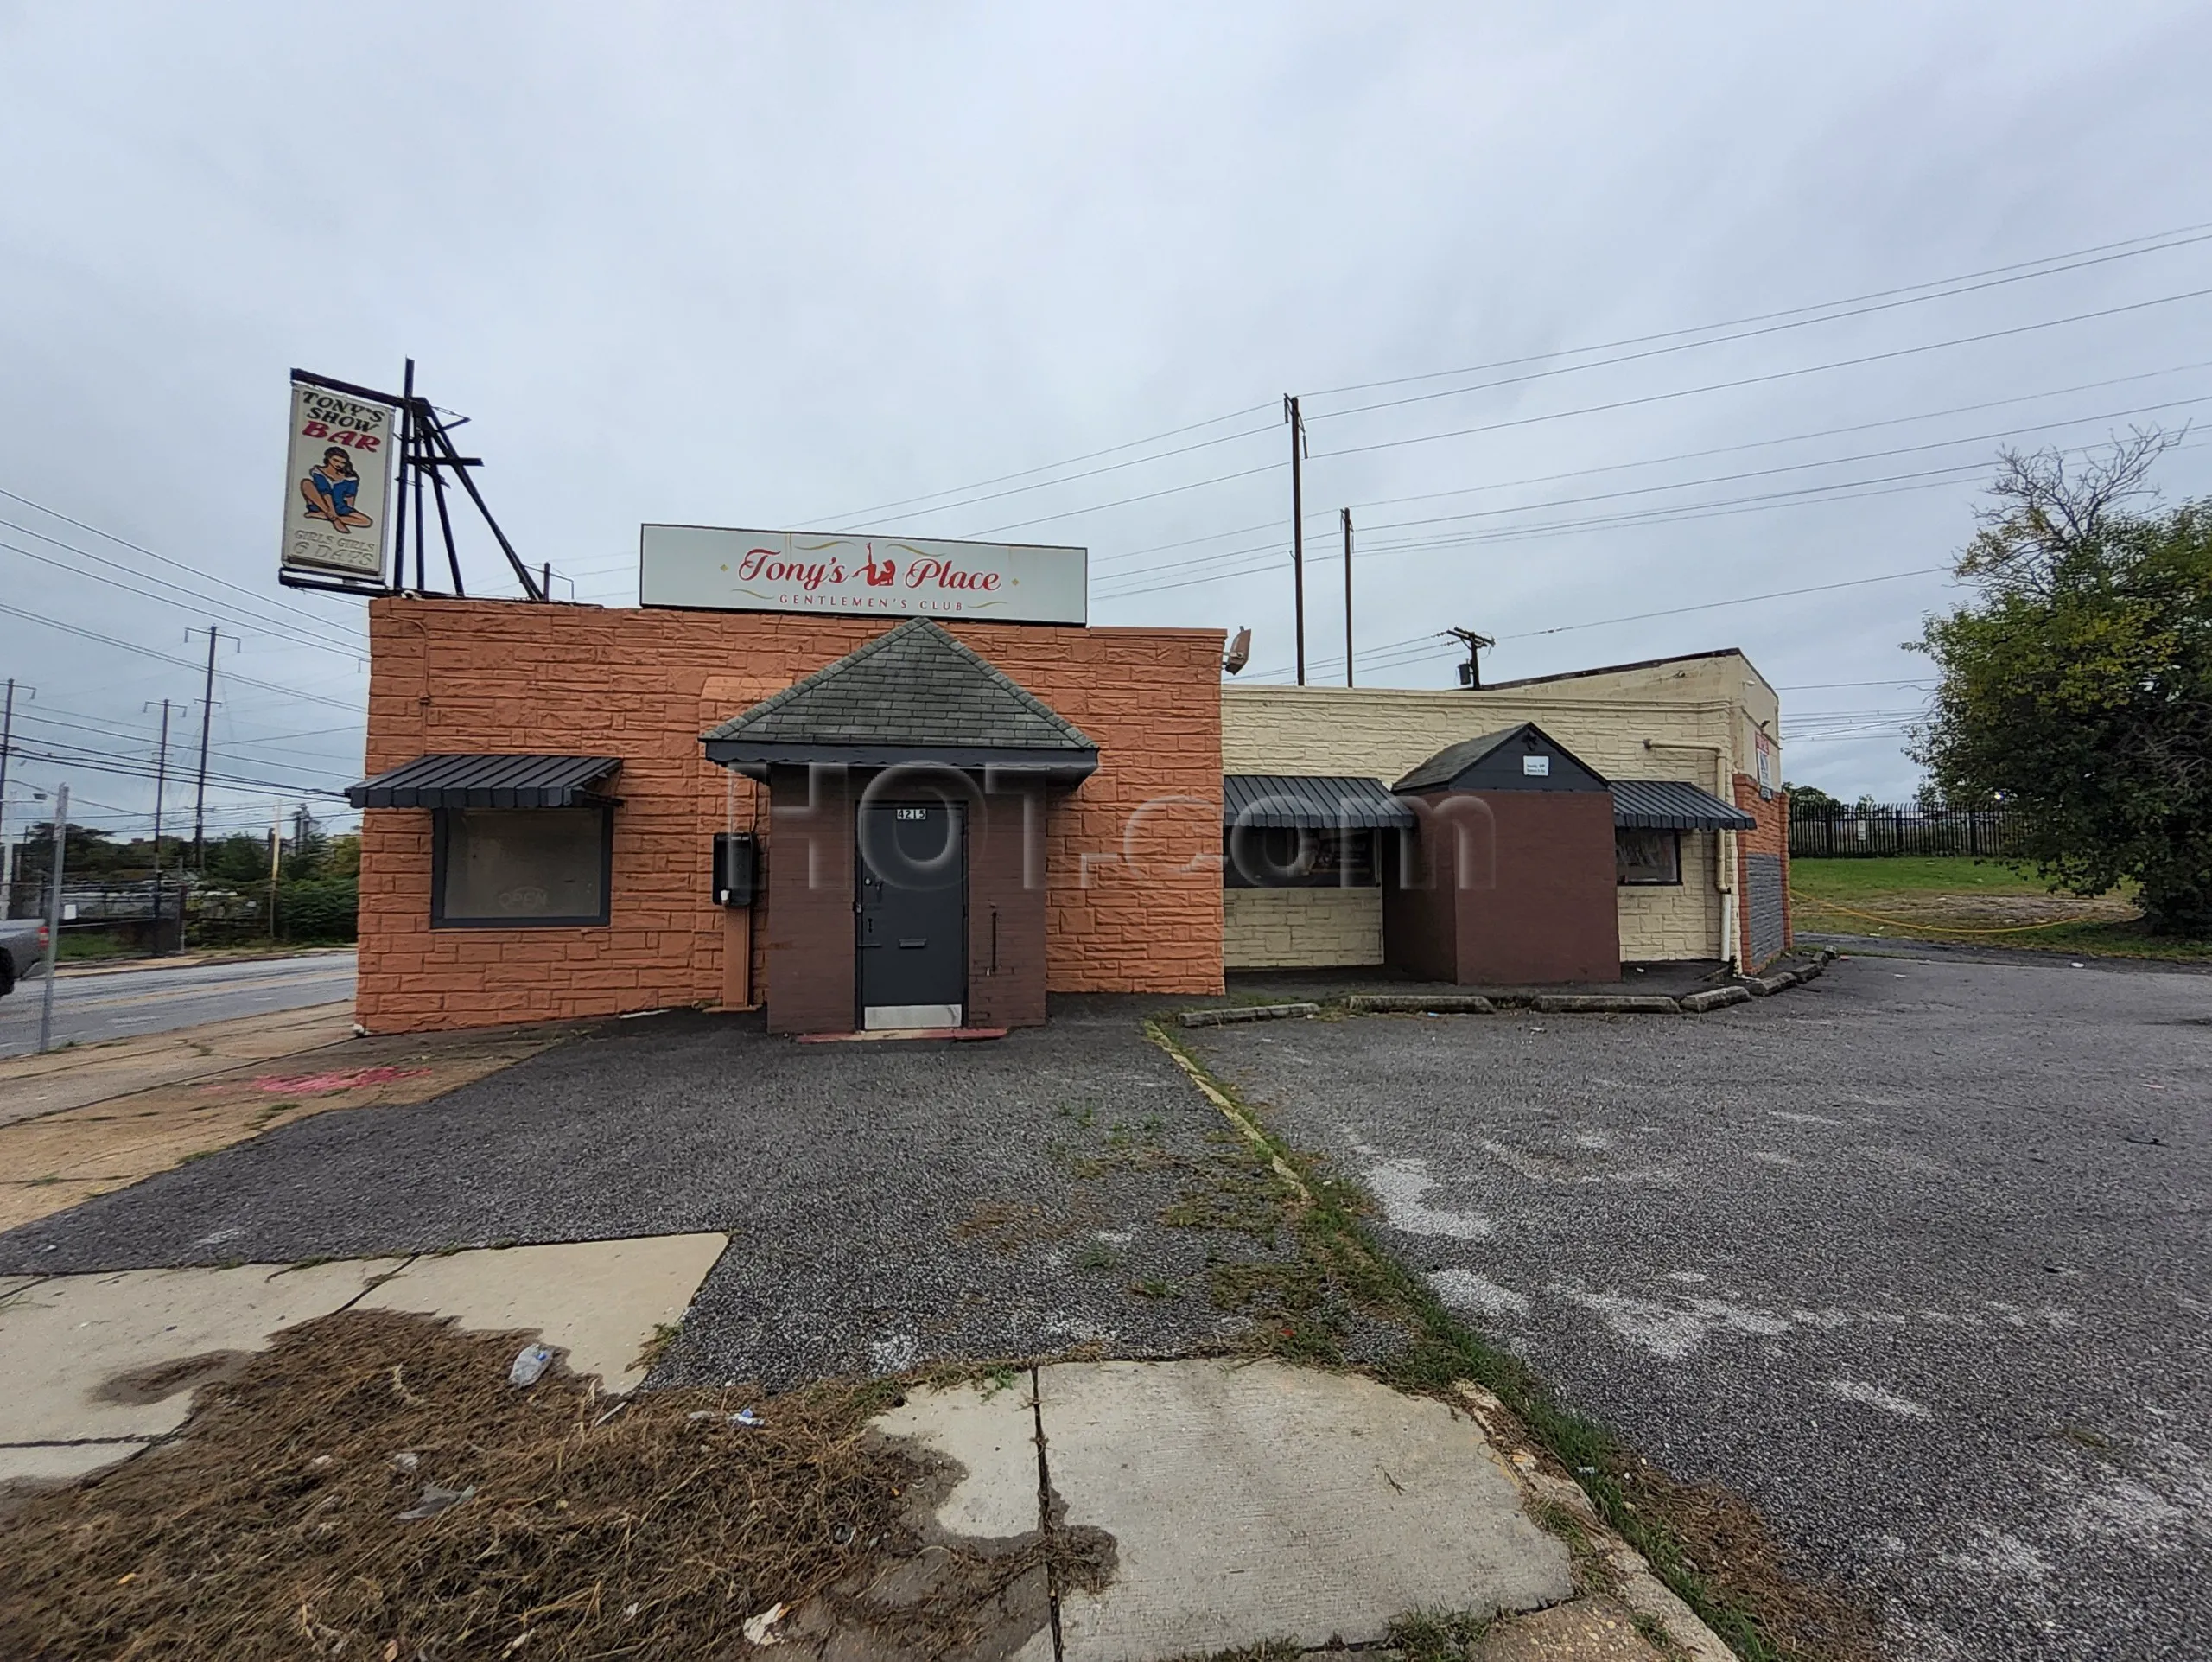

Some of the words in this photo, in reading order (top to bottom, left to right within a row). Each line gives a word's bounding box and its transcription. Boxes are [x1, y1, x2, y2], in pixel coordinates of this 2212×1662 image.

[302, 391, 385, 423] TONY'S
[306, 406, 380, 432] SHOW
[302, 420, 381, 453] BAR
[295, 530, 334, 545] GIRLS
[337, 538, 375, 552] GIRLS
[314, 544, 374, 566] DAYS
[739, 548, 849, 591] Tony's
[905, 558, 1001, 591] Place
[779, 594, 907, 609] GENTLEMEN'S
[919, 600, 963, 611] CLUB
[897, 809, 925, 819] 4215
[499, 891, 548, 909] OPEN
